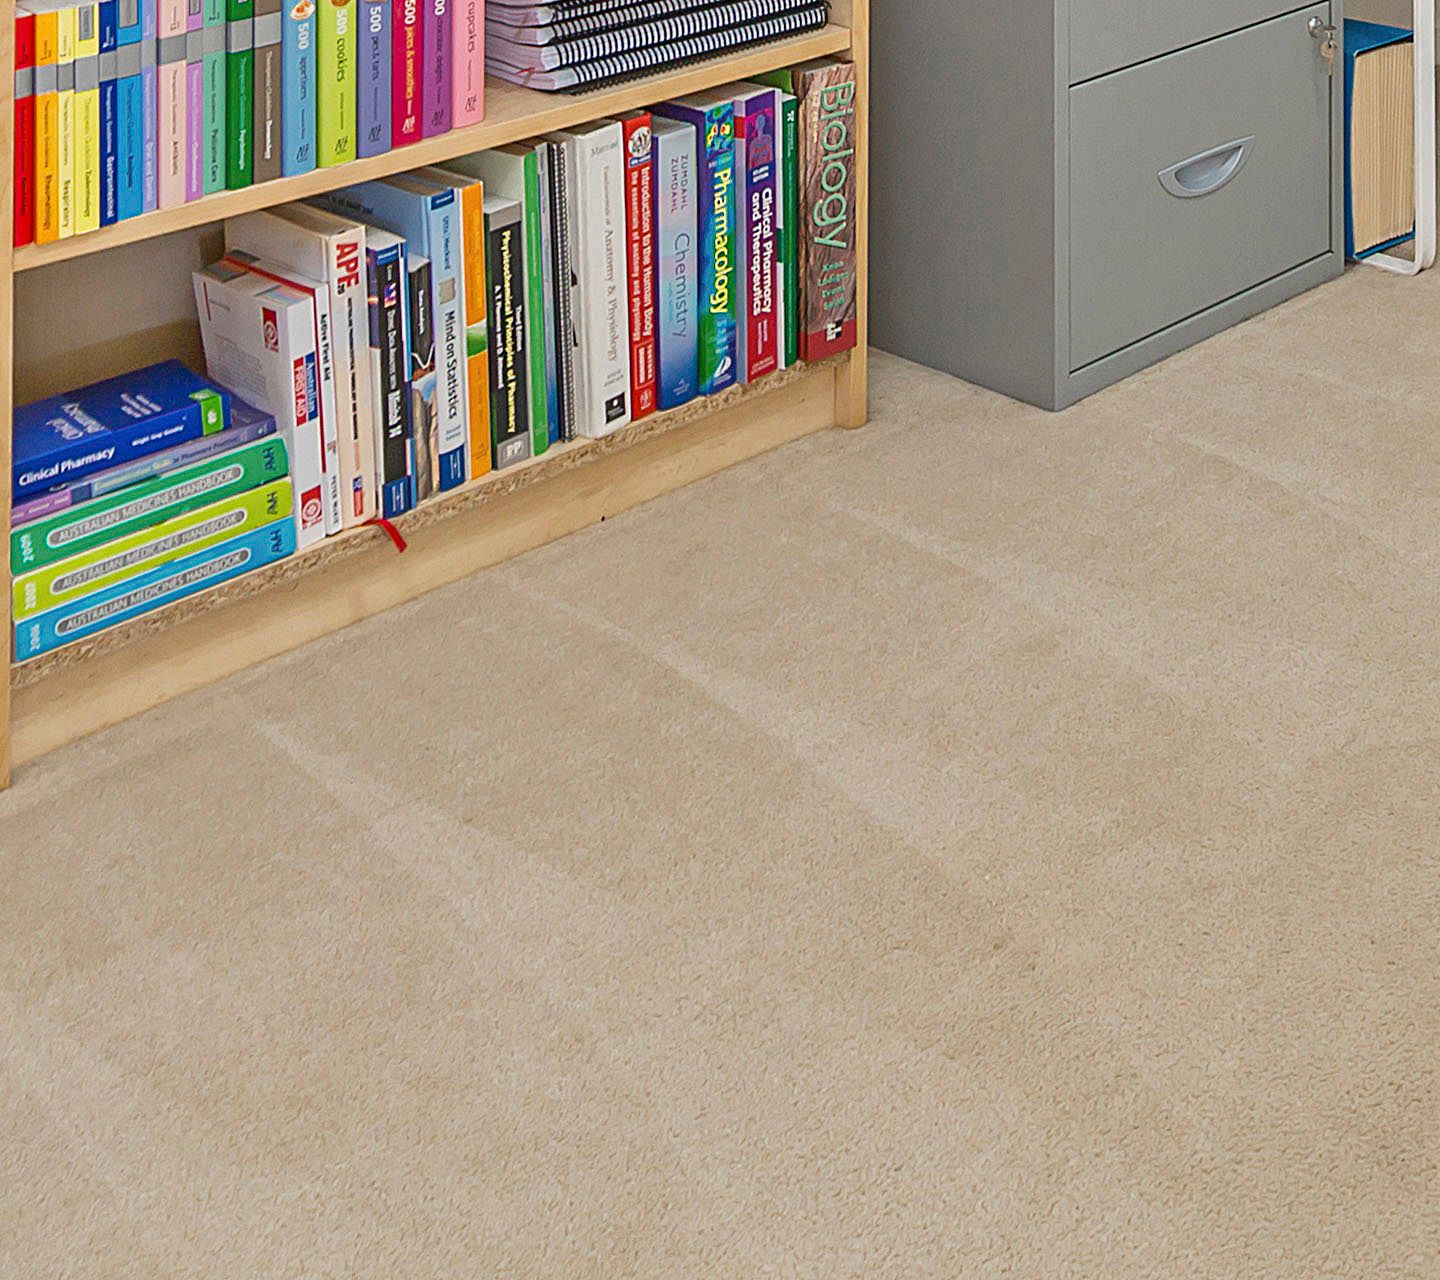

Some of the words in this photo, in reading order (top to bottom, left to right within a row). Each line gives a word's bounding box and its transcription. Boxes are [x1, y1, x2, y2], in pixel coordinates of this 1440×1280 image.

[813, 81, 855, 248] Biology
[710, 168, 732, 315] Pharmacology
[59, 511, 119, 542] AUSTRALIAN
[122, 491, 177, 518] MEDICINES
[178, 469, 236, 497] HANDBOOK
